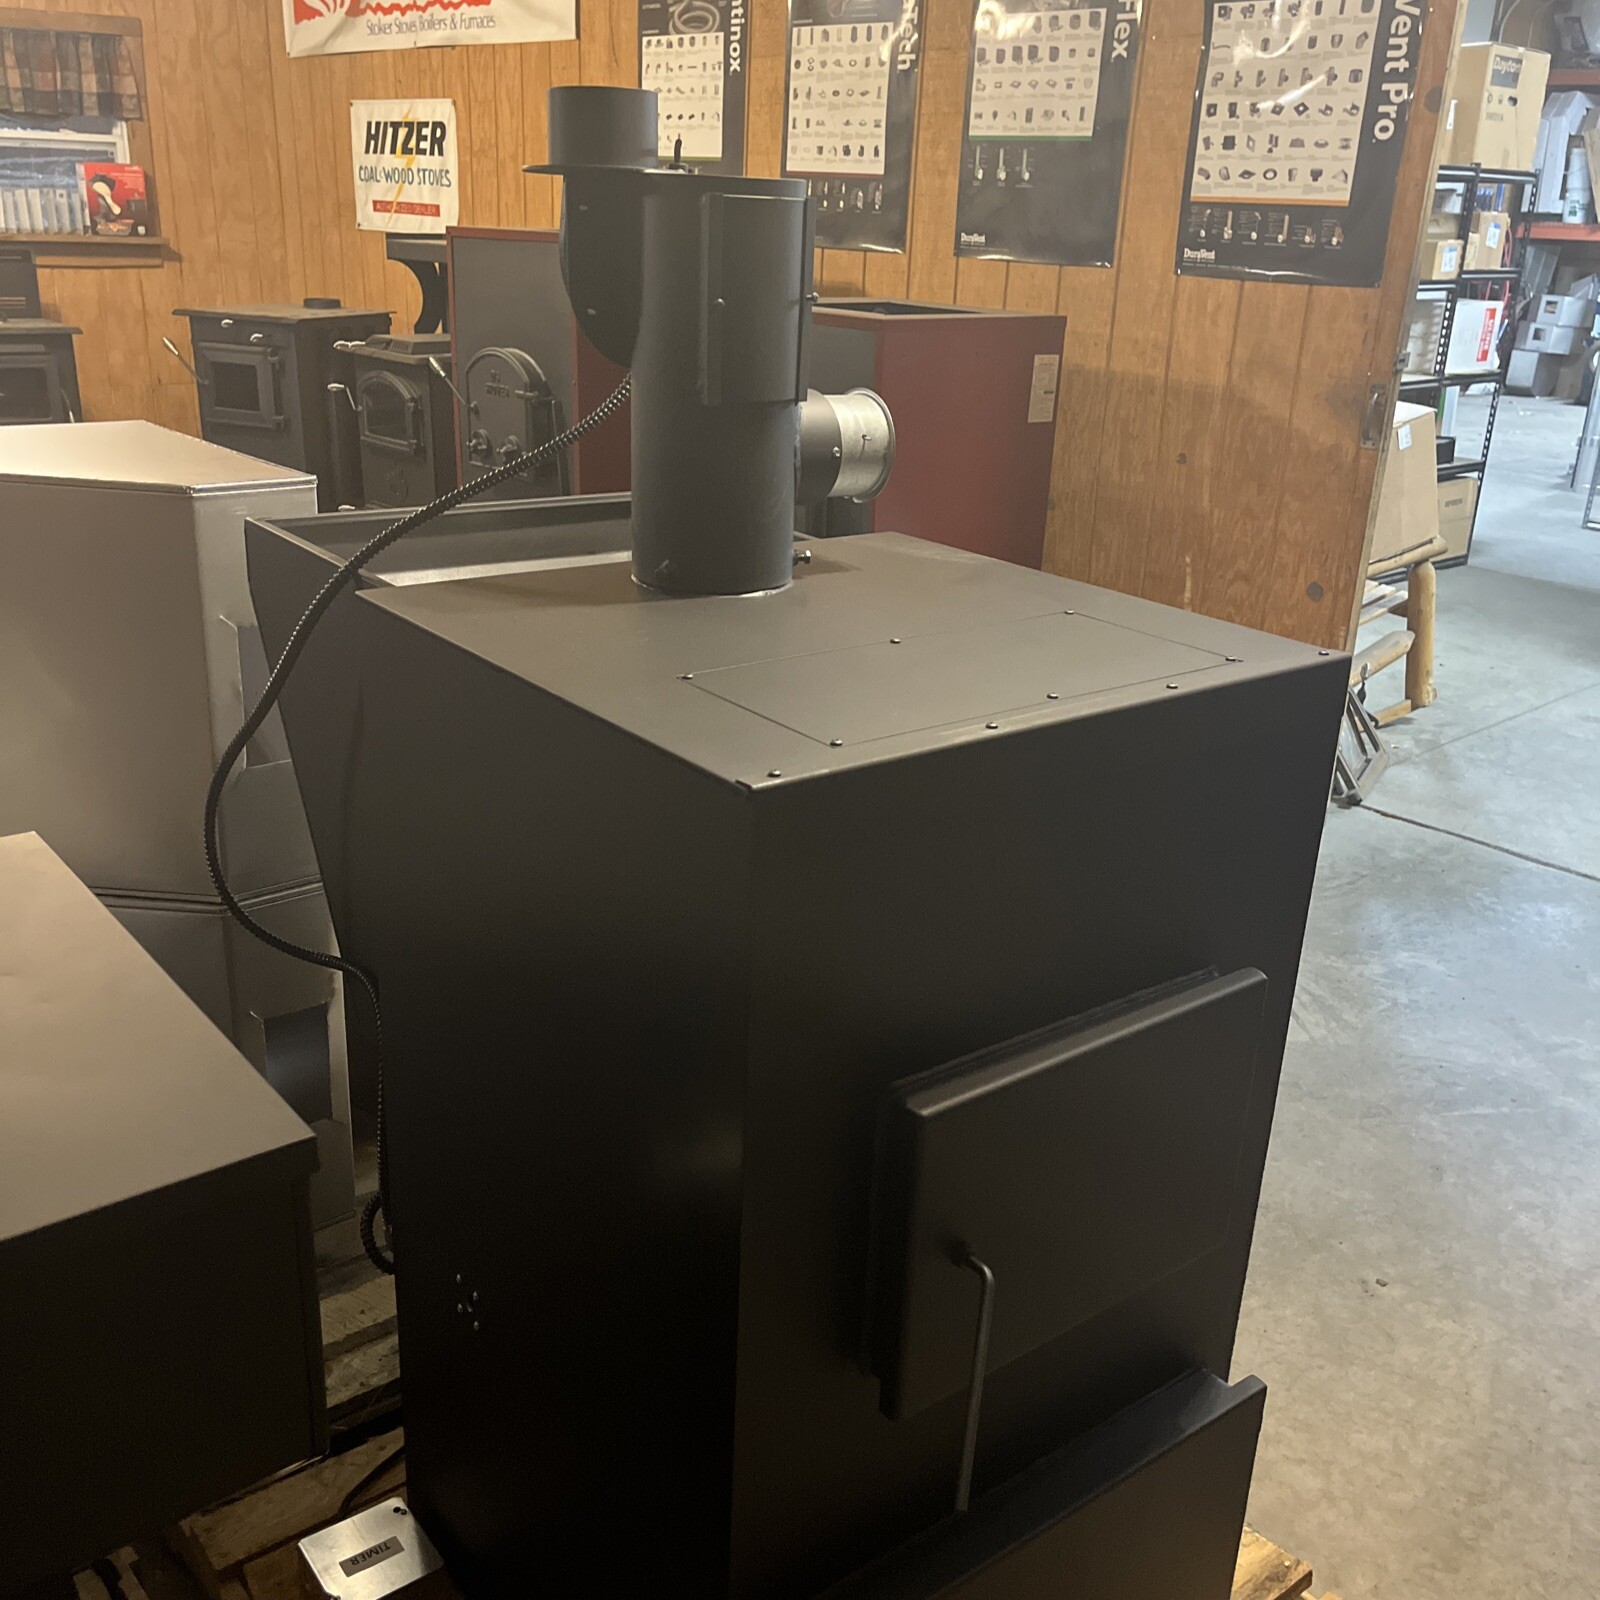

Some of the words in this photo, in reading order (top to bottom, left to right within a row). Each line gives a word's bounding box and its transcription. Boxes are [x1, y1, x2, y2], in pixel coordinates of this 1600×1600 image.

[366, 18, 393, 36] Stoker
[450, 13, 459, 31] &
[1111, 0, 1138, 59] Flex
[1383, 0, 1421, 73] Vent
[1374, 83, 1409, 141] Pro
[364, 120, 447, 157] HITZER
[358, 165, 381, 183] COAL
[383, 167, 415, 185] WOOD
[417, 167, 452, 188] STOVES
[349, 1542, 392, 1566] TIMER
